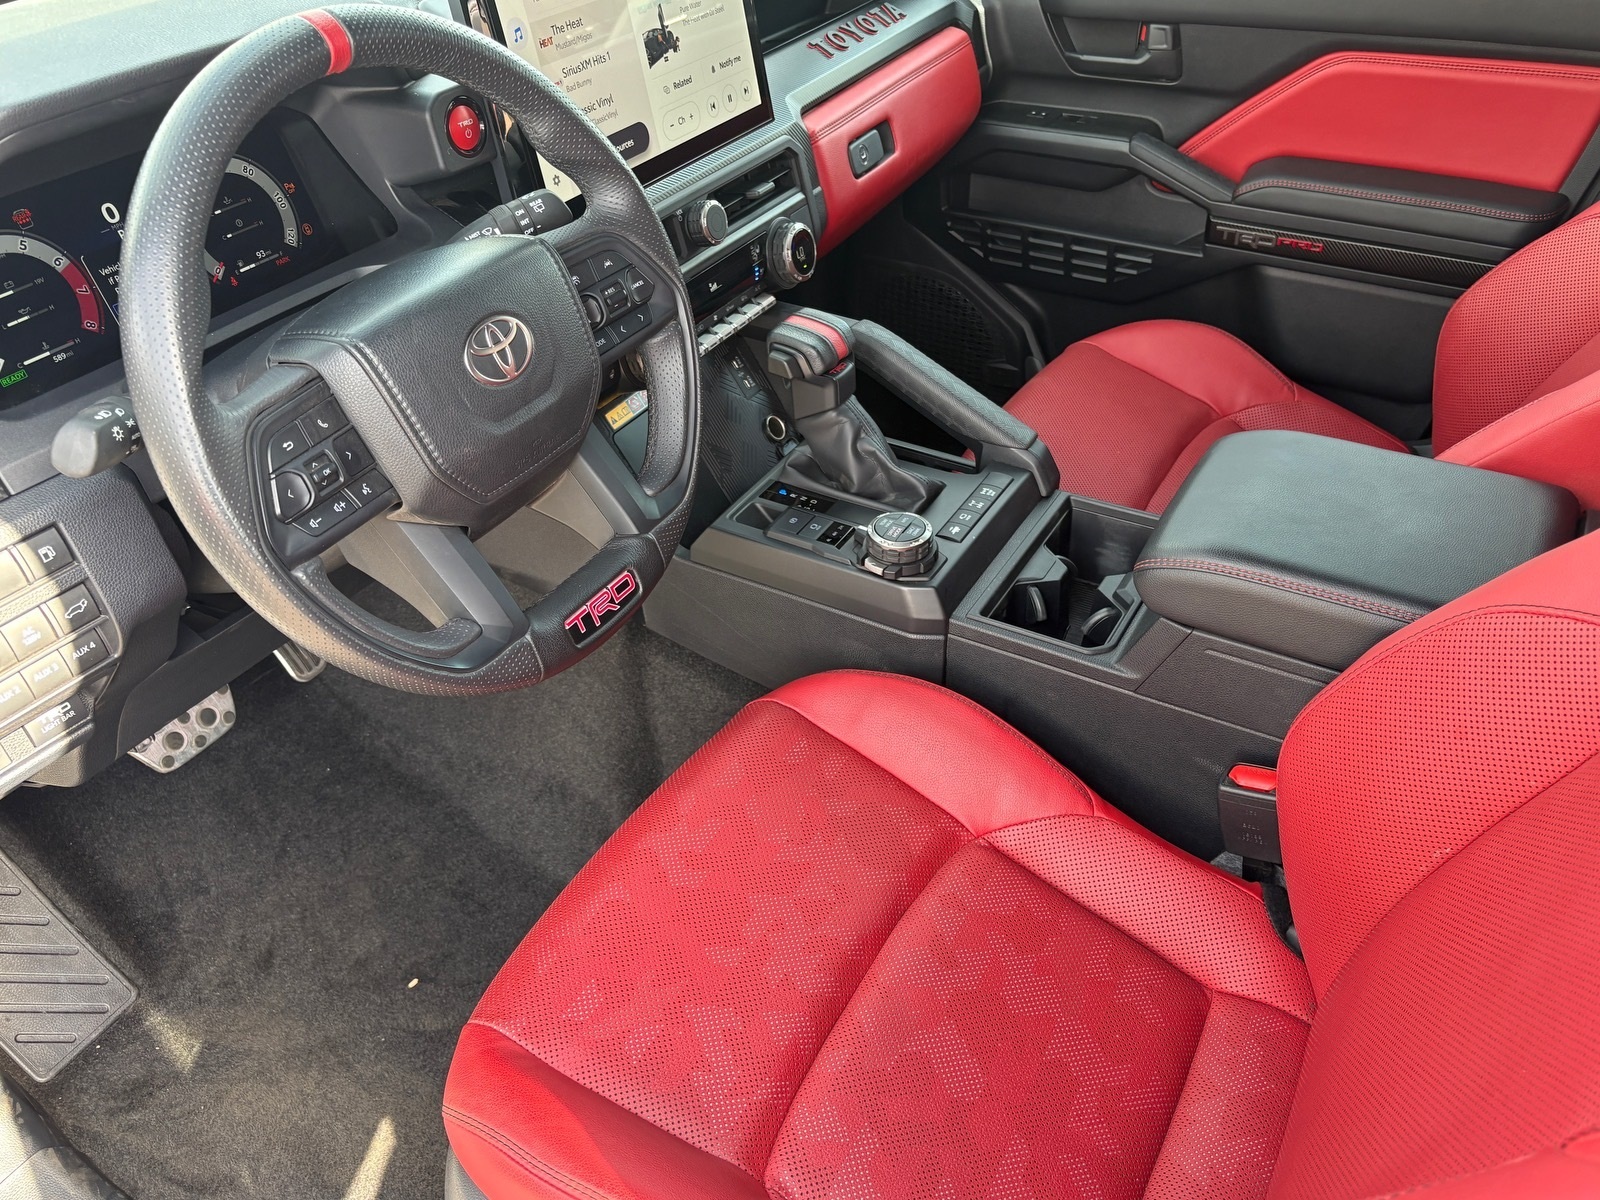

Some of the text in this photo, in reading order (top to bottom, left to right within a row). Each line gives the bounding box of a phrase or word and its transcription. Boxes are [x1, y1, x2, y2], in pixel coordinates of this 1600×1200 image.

[550, 17, 584, 36] The Heat
[806, 2, 907, 59] TOYOTA
[539, 36, 554, 48] HEAT
[555, 32, 593, 51] Mustard/Migos
[561, 51, 612, 78] SiriusXM Hits 1
[718, 55, 742, 70] Notify me
[566, 81, 577, 93] Bad
[577, 78, 592, 90] Bunny
[672, 75, 692, 90] Related
[596, 93, 614, 108] Vinyl
[458, 119, 474, 128] TRD
[678, 116, 686, 126] Ch
[615, 139, 634, 152] ources
[242, 165, 254, 176] 80
[274, 192, 287, 209] 100
[529, 198, 542, 208] REAR
[101, 202, 120, 224] 0
[515, 208, 525, 216] ON
[520, 218, 530, 226] INT
[524, 227, 534, 236] OFF
[1216, 225, 1324, 253] TRD PRO
[19, 240, 28, 251] 5
[256, 250, 266, 259] 93
[53, 257, 64, 267] 6
[276, 256, 290, 266] PARK
[98, 262, 121, 276] Vehic
[76, 284, 90, 295] 7
[631, 280, 644, 290] CANCEL
[84, 320, 97, 330] 8
[596, 338, 606, 348] ODE
[52, 352, 66, 363] 589
[2, 371, 25, 386] READY
[322, 468, 332, 476] OK
[564, 570, 636, 634] TRD
[72, 645, 90, 660] AUX
[34, 662, 60, 682] AUX 3
[14, 686, 22, 694] 2
[41, 710, 76, 734] LIGHT BAR
